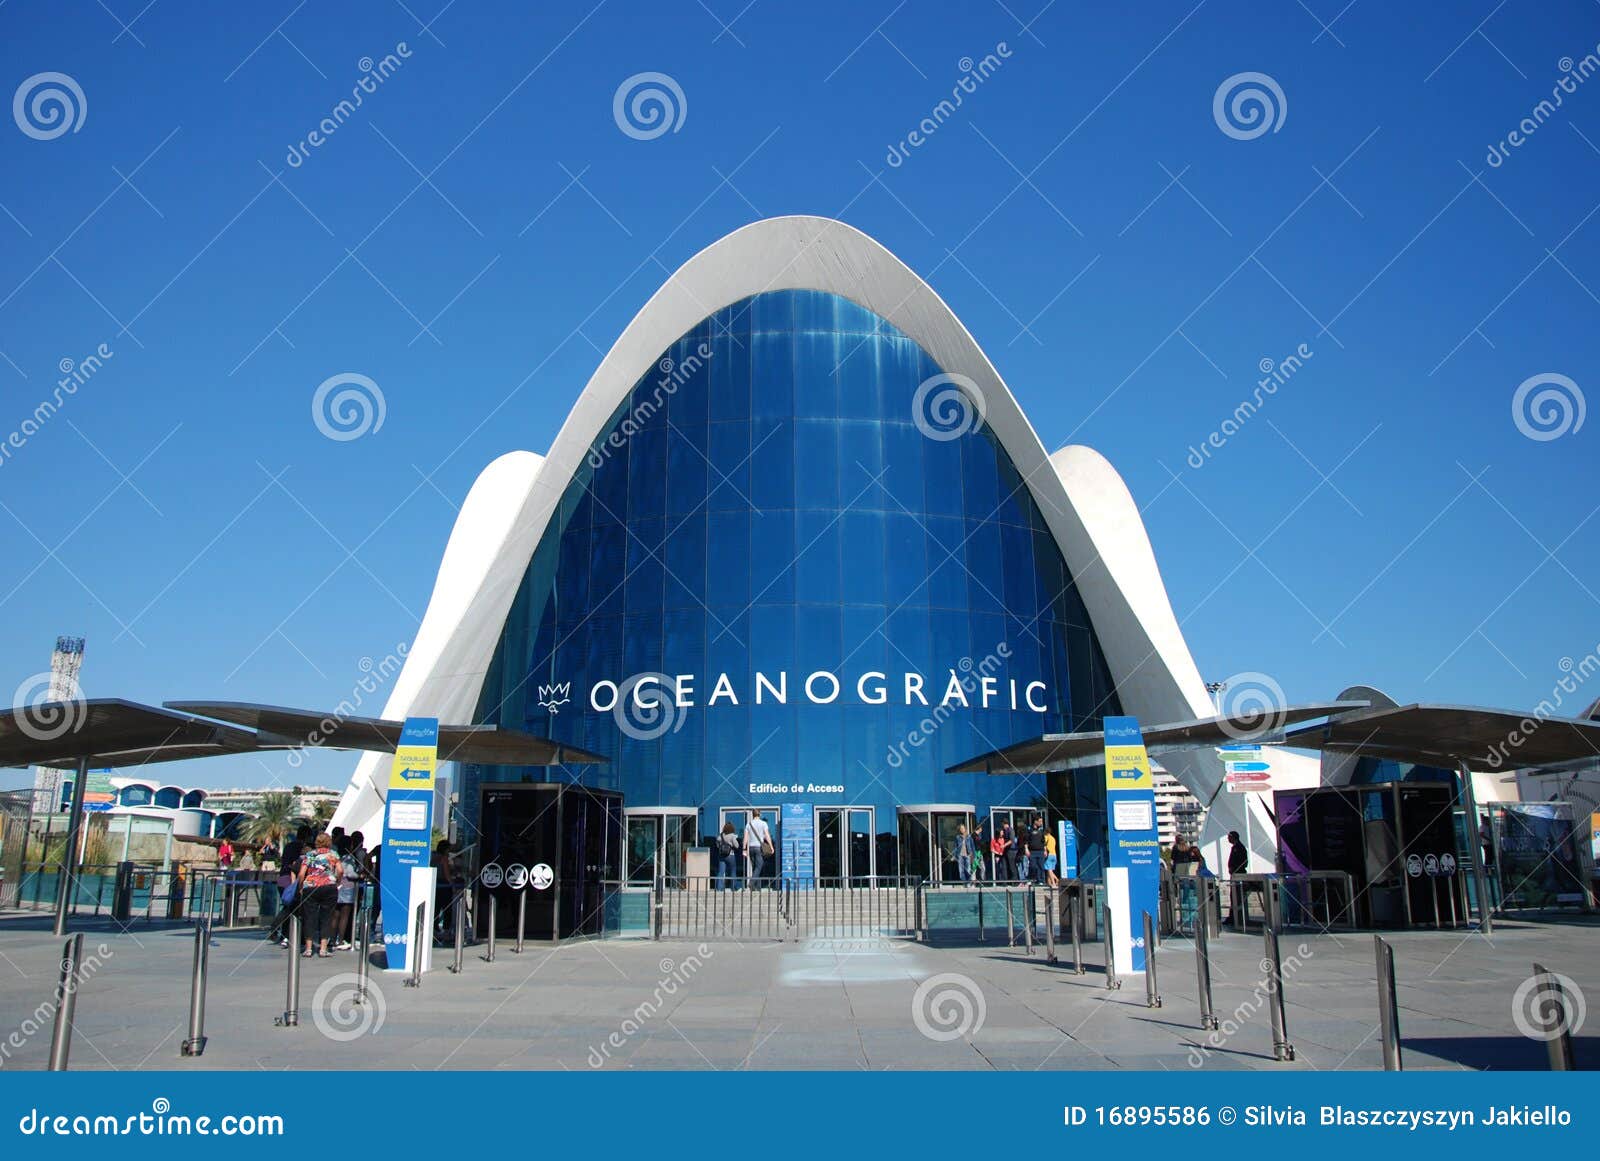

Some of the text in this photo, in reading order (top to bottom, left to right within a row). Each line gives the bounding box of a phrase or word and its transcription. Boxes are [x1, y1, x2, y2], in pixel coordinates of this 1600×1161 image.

[590, 669, 1047, 712] OCEANOGRÀFIC
[749, 783, 844, 793] Edificio de Acceso
